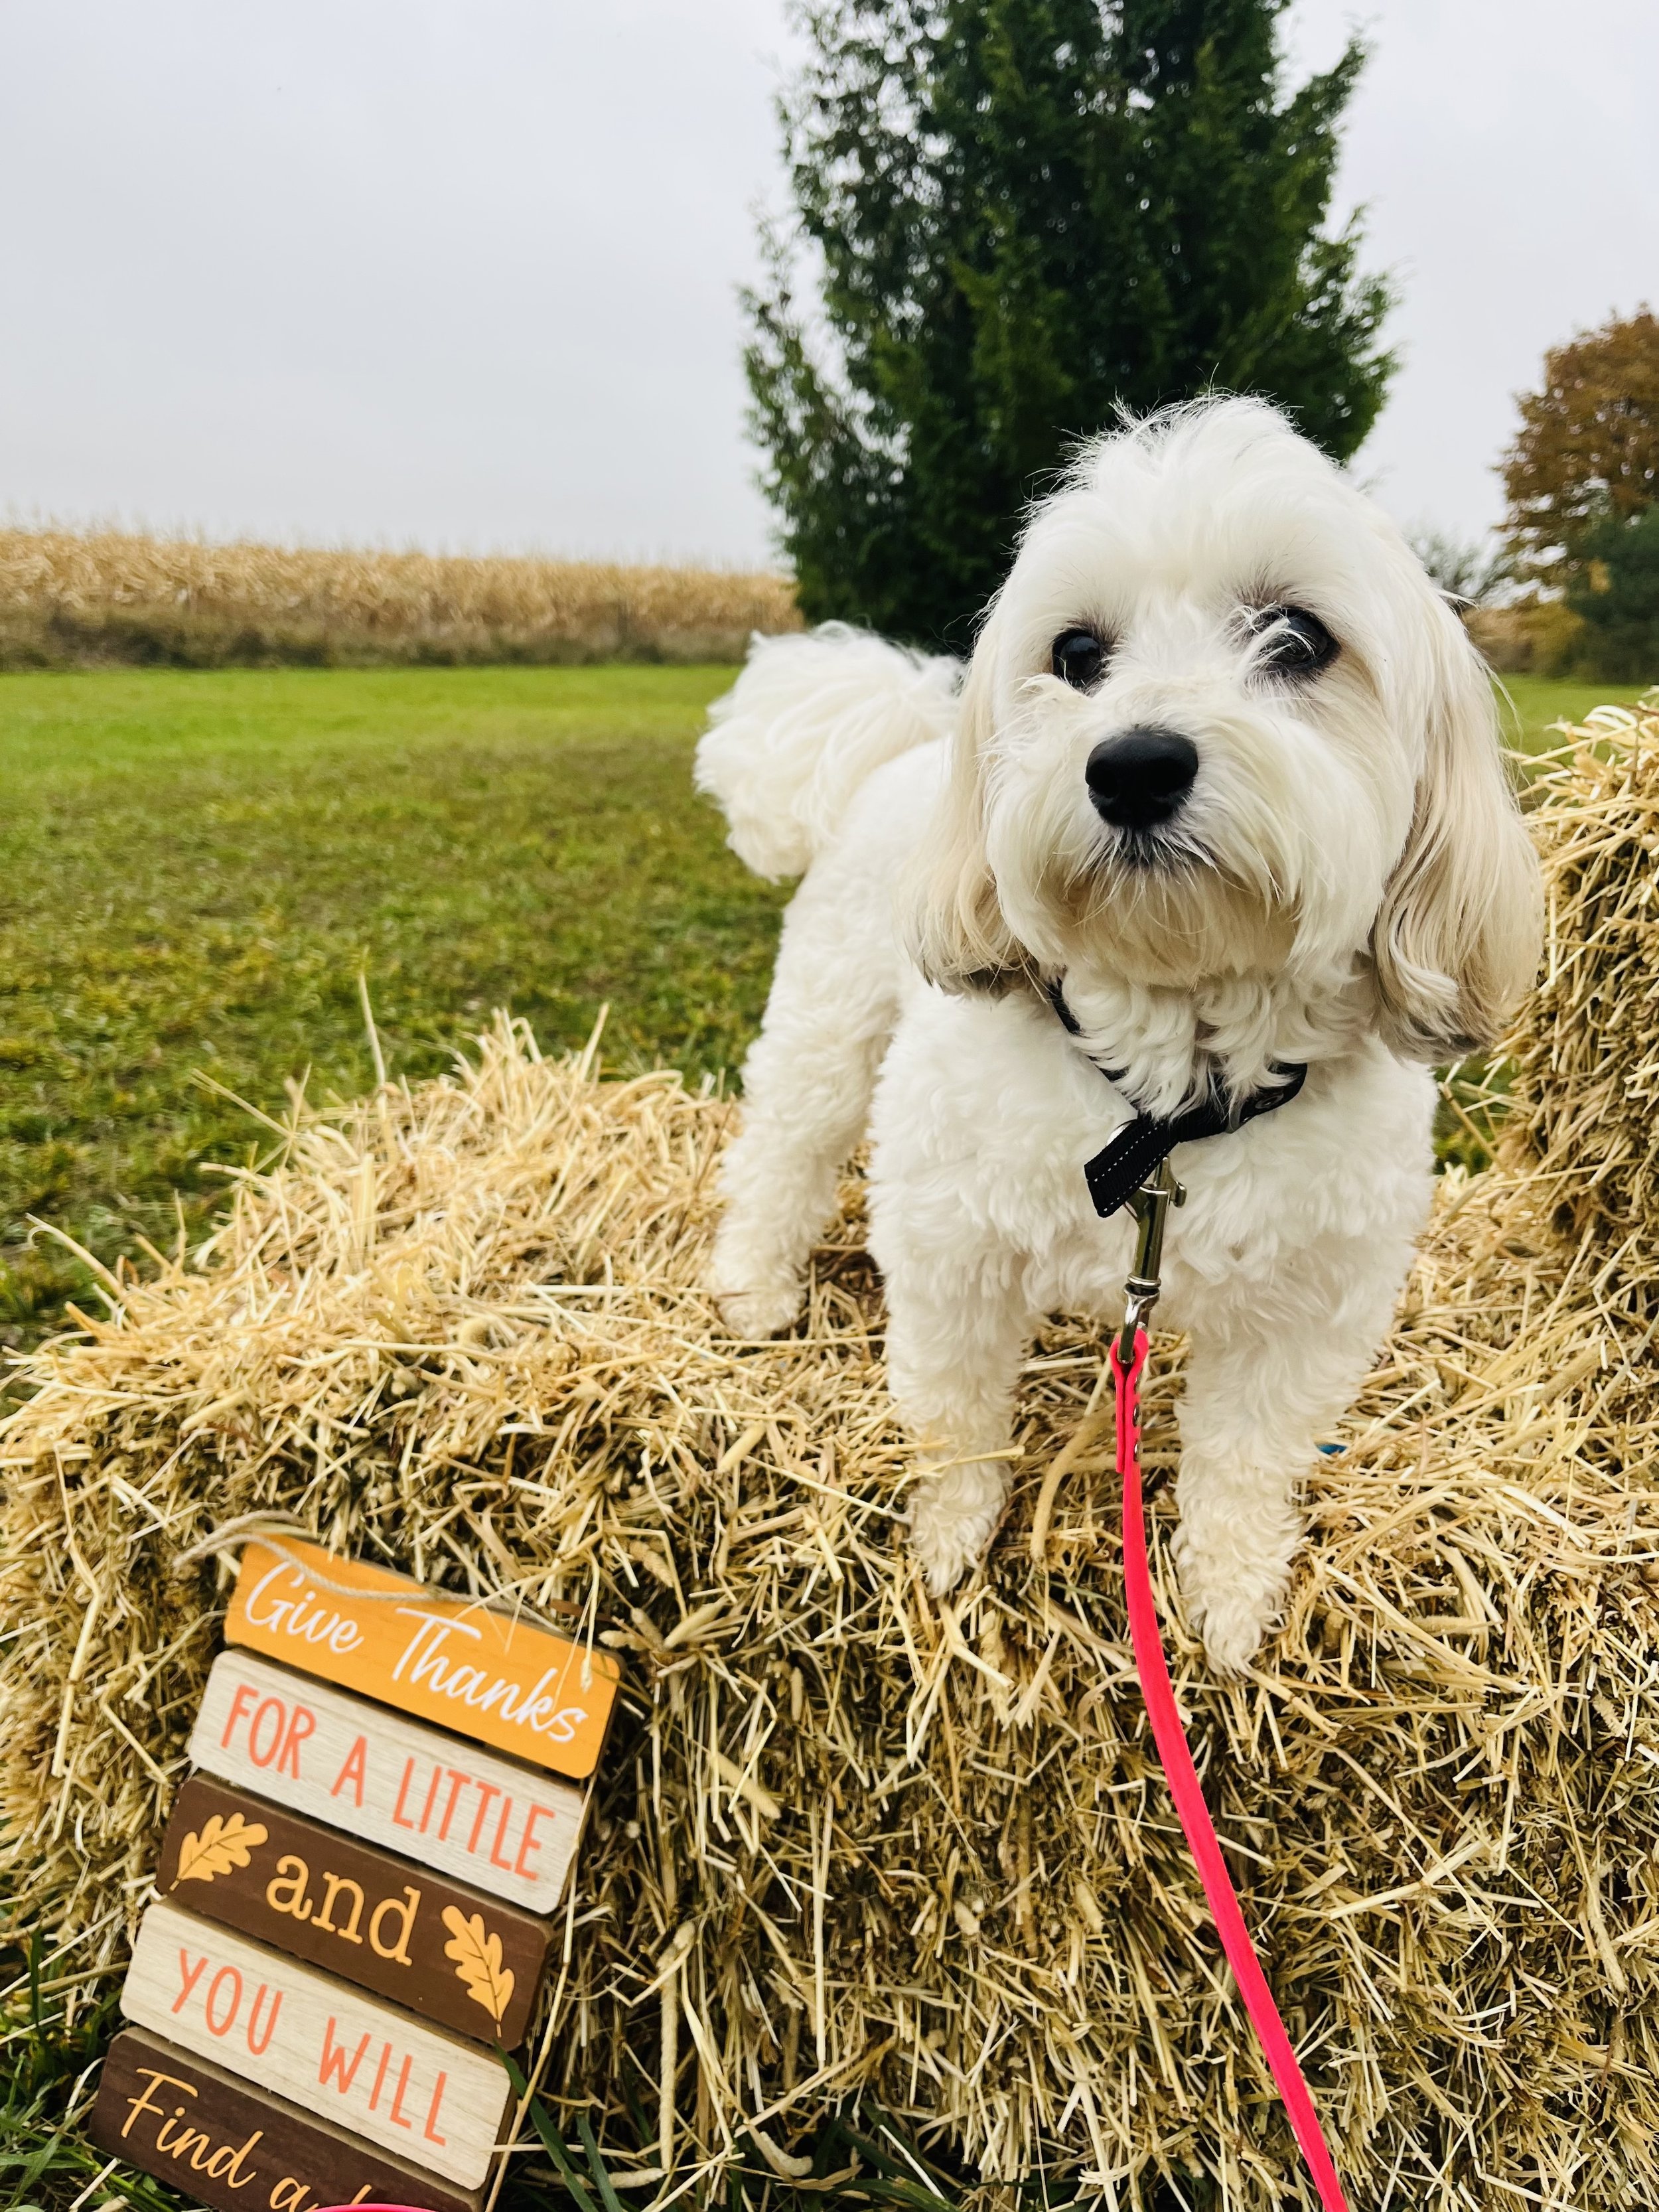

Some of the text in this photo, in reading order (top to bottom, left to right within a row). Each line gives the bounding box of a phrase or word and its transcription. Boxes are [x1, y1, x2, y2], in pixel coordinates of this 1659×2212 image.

[244, 1558, 589, 1743] Give Thanks
[220, 1684, 555, 1881] FOR A LITTLE
[266, 1852, 422, 1966] and
[120, 2067, 265, 2189] Find
[170, 1948, 447, 2146] YOU WILL
